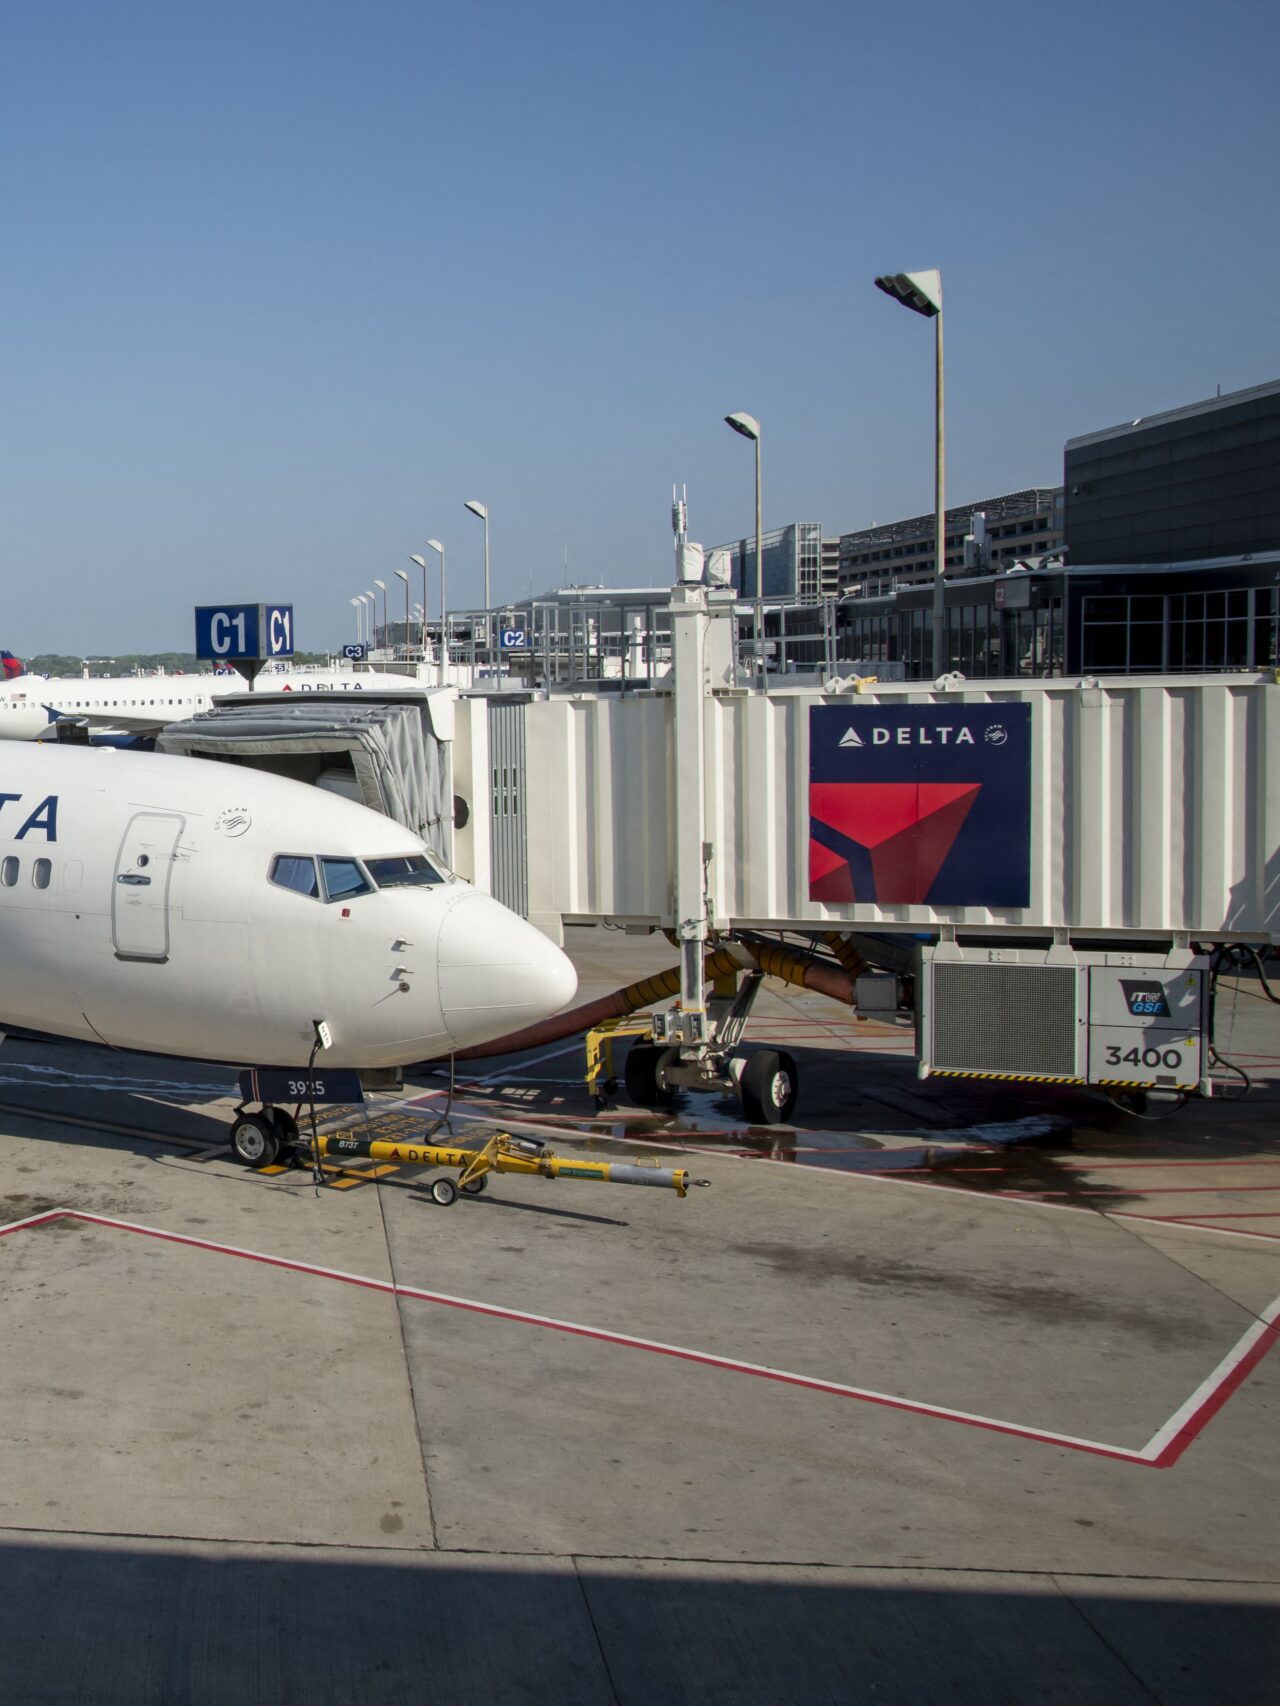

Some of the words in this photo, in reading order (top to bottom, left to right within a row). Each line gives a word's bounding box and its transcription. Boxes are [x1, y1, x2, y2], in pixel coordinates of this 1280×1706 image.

[210, 612, 246, 654] C1
[270, 610, 290, 654] C1
[503, 631, 525, 646] C2
[345, 646, 363, 658] C3
[872, 726, 975, 745] DELTA
[1130, 992, 1162, 1002] ITW
[1132, 1002, 1165, 1013] GSE
[1104, 1045, 1182, 1070] 3400
[287, 1080, 325, 1095] 3925
[338, 1140, 359, 1149] B737
[408, 1149, 469, 1167] DELTA
